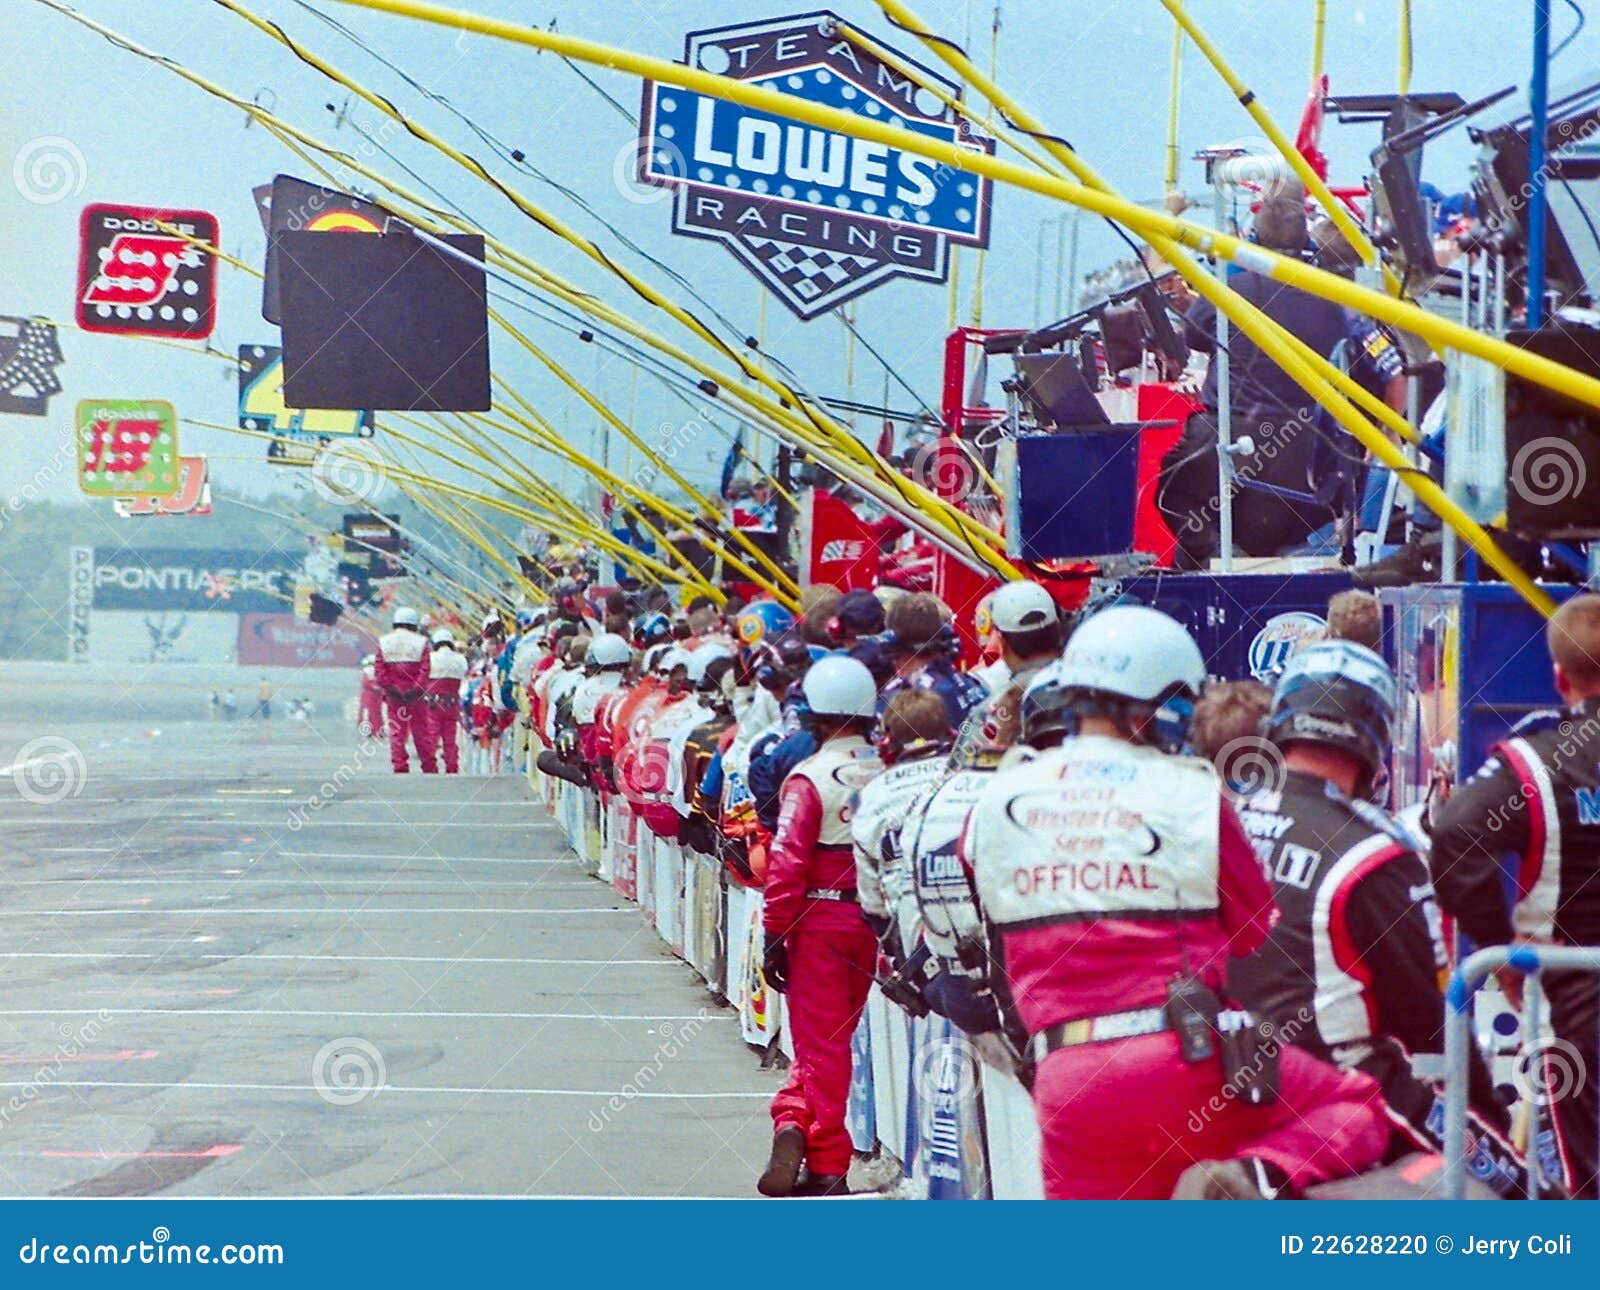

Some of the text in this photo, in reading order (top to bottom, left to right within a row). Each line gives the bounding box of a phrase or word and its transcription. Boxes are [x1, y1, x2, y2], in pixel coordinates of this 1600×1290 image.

[730, 34, 916, 103] TEAM
[697, 197, 921, 258] RACING
[1013, 862, 1159, 896] OFFICIAL
